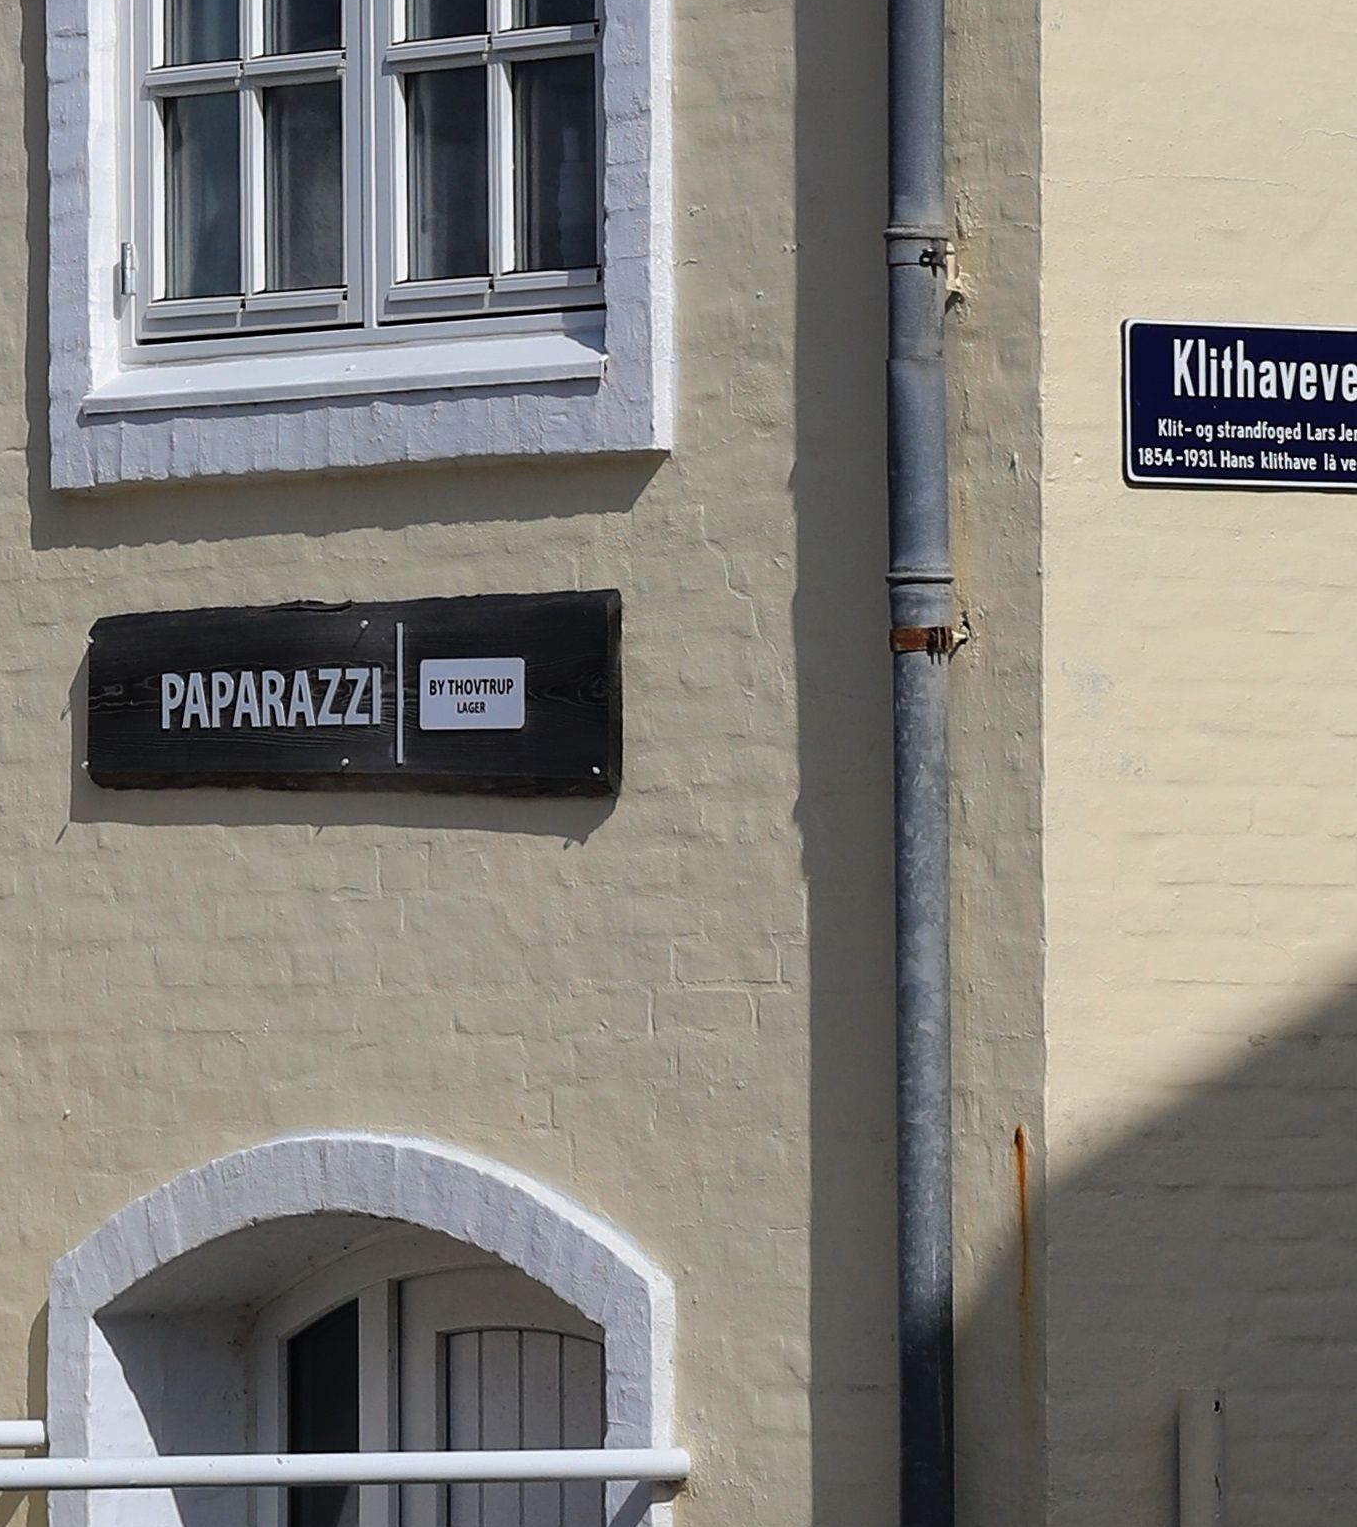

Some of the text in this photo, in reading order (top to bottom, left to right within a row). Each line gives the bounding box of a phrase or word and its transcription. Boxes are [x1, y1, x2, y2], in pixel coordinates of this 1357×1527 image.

[1157, 418, 1193, 437] Klit-
[1195, 424, 1213, 443] og
[1216, 420, 1302, 444] strandfoged
[1306, 422, 1336, 441] Lars
[1220, 450, 1255, 469] Hans
[1260, 451, 1317, 471] klithave
[429, 678, 514, 696] BY THOVTRUP
[160, 666, 382, 730] PAPARAZZI
[456, 701, 486, 714] LAGER
